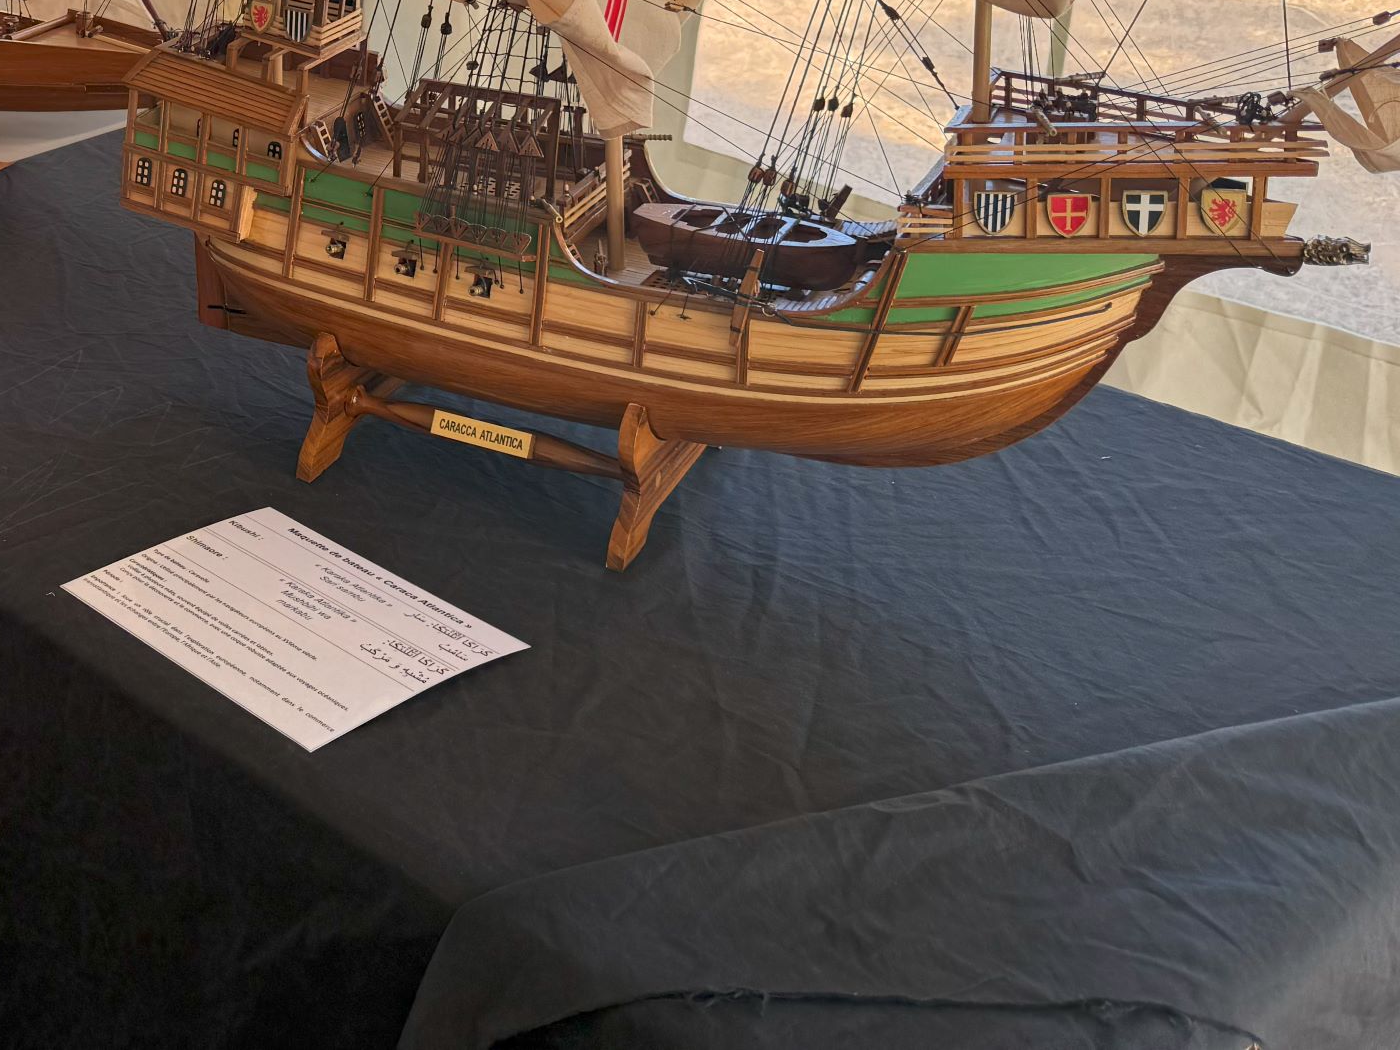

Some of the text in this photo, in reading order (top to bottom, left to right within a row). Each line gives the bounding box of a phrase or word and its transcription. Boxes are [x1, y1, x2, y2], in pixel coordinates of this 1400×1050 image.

[439, 418, 523, 451] CARACCA ATLANTICA
[228, 520, 261, 538] Kibushi
[185, 535, 224, 557] Shimaore
[286, 528, 330, 551] Maquette
[328, 550, 343, 558] de
[341, 557, 376, 576] bateau
[382, 580, 419, 599] Caraca
[417, 599, 465, 624] Atlantica
